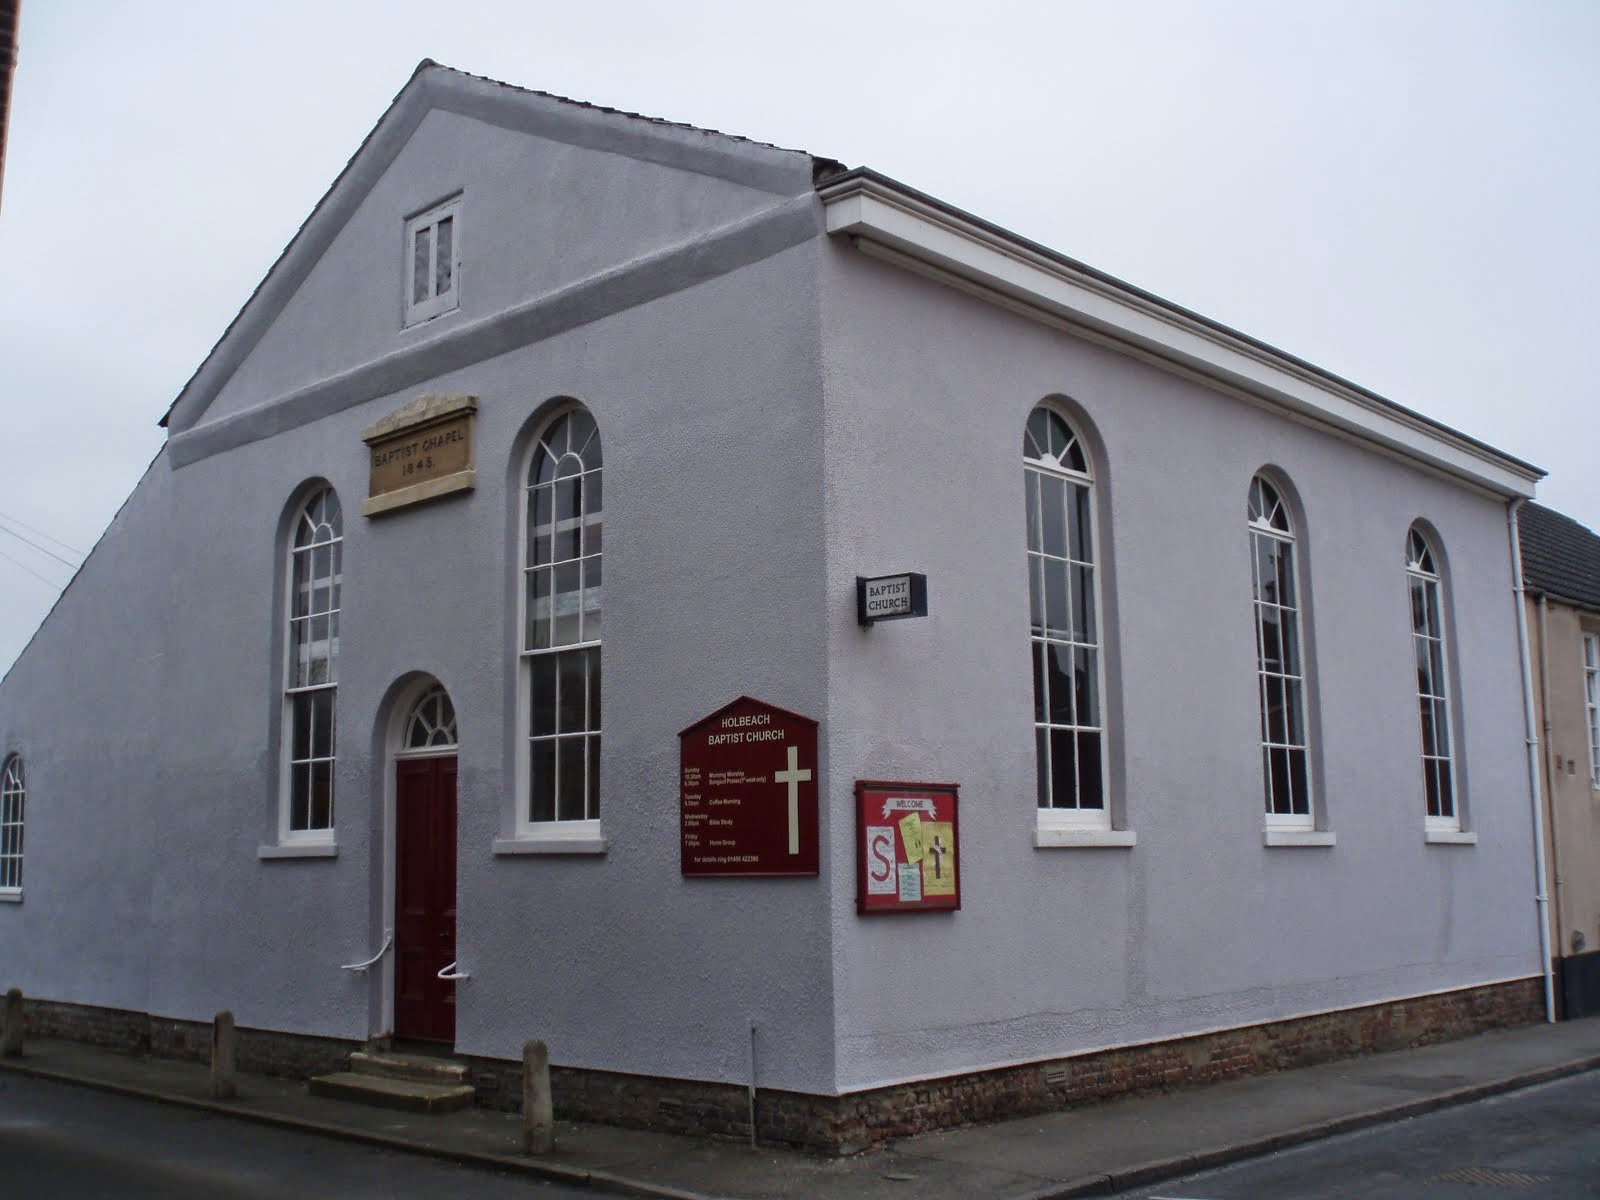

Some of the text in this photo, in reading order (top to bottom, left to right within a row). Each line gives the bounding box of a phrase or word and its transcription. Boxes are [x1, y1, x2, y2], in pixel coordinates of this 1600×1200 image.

[375, 430, 464, 467] BAPTIST CHAPEL
[869, 582, 906, 596] BAPTIST
[868, 597, 907, 610] CHURCH
[721, 714, 770, 728] HOLBEACH
[708, 729, 785, 745] BAPTIST CHURCH
[717, 856, 727, 864] ring
